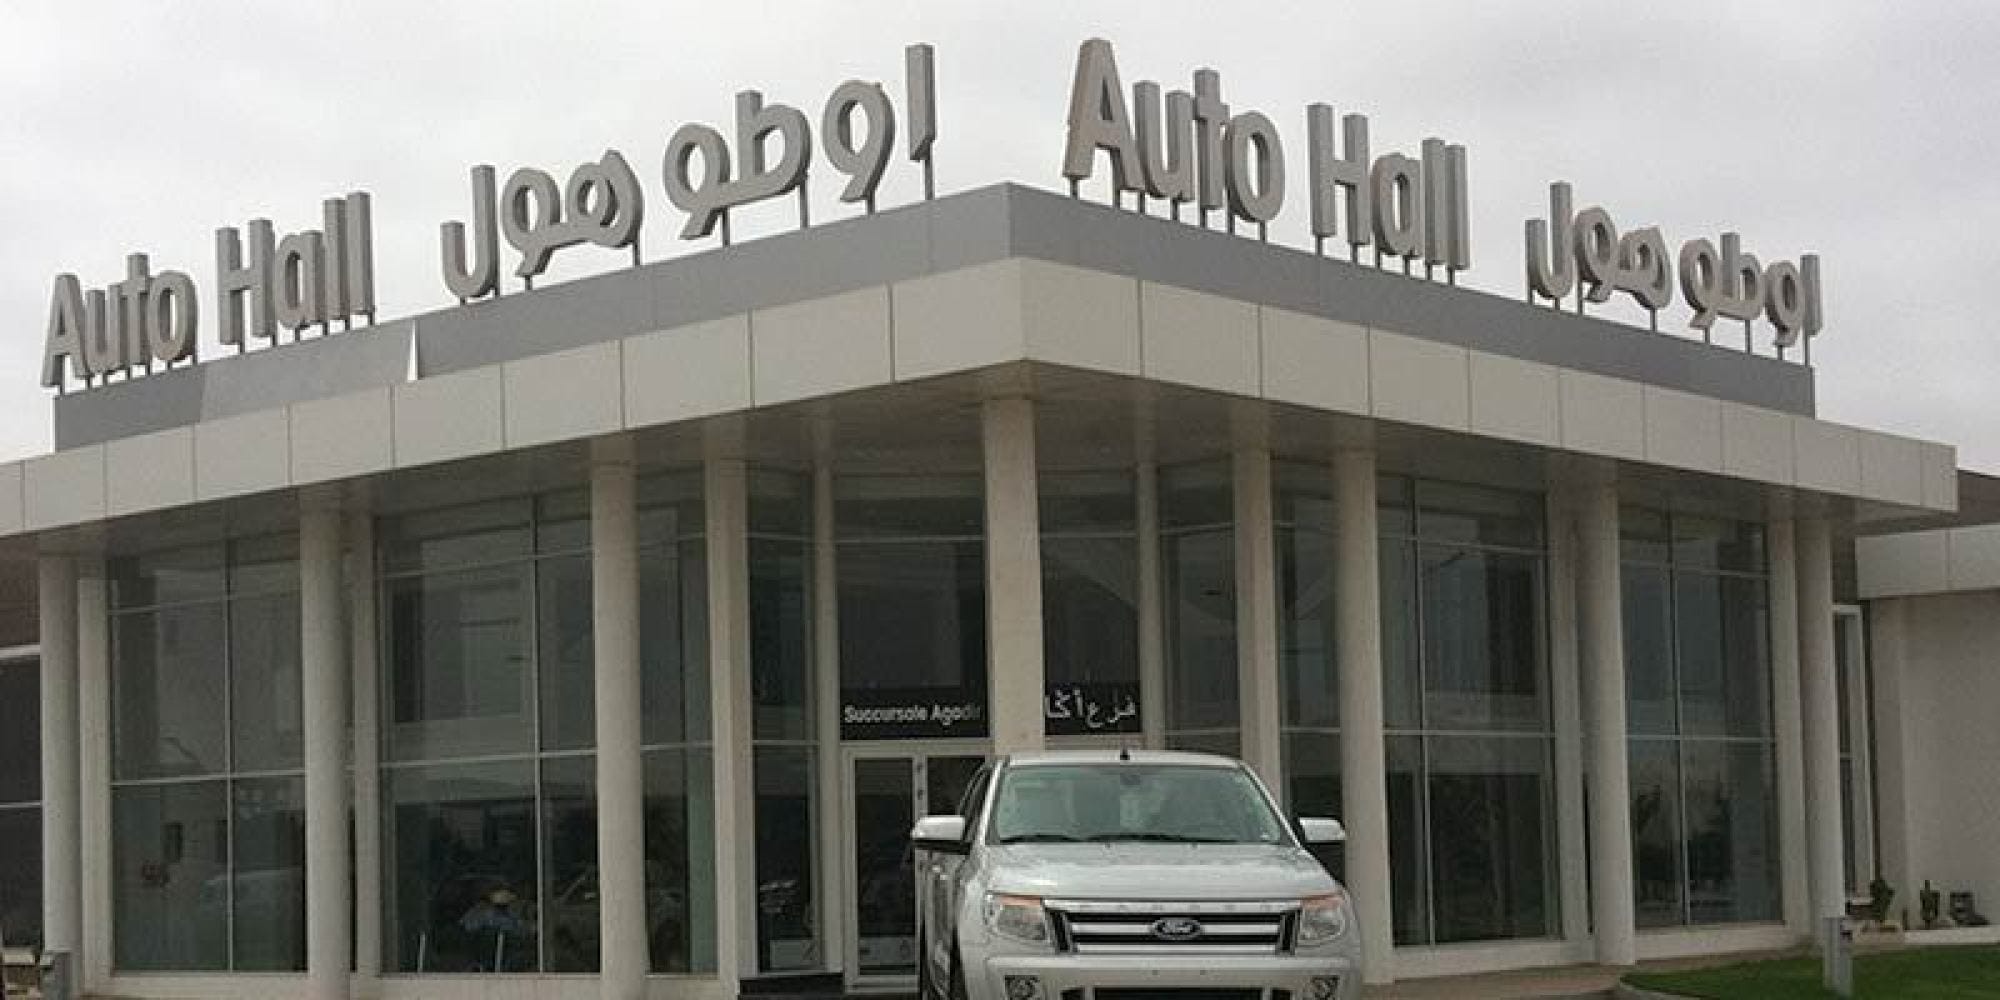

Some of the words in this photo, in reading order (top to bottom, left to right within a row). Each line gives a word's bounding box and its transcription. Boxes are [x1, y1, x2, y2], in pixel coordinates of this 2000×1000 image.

[440, 148, 643, 299] هول
[1063, 37, 1285, 222] Auto
[1307, 102, 1471, 270] Hall
[40, 251, 198, 387] Auto
[214, 190, 374, 344] Hall
[1525, 180, 1673, 310] هول
[844, 703, 928, 723] Succursale
